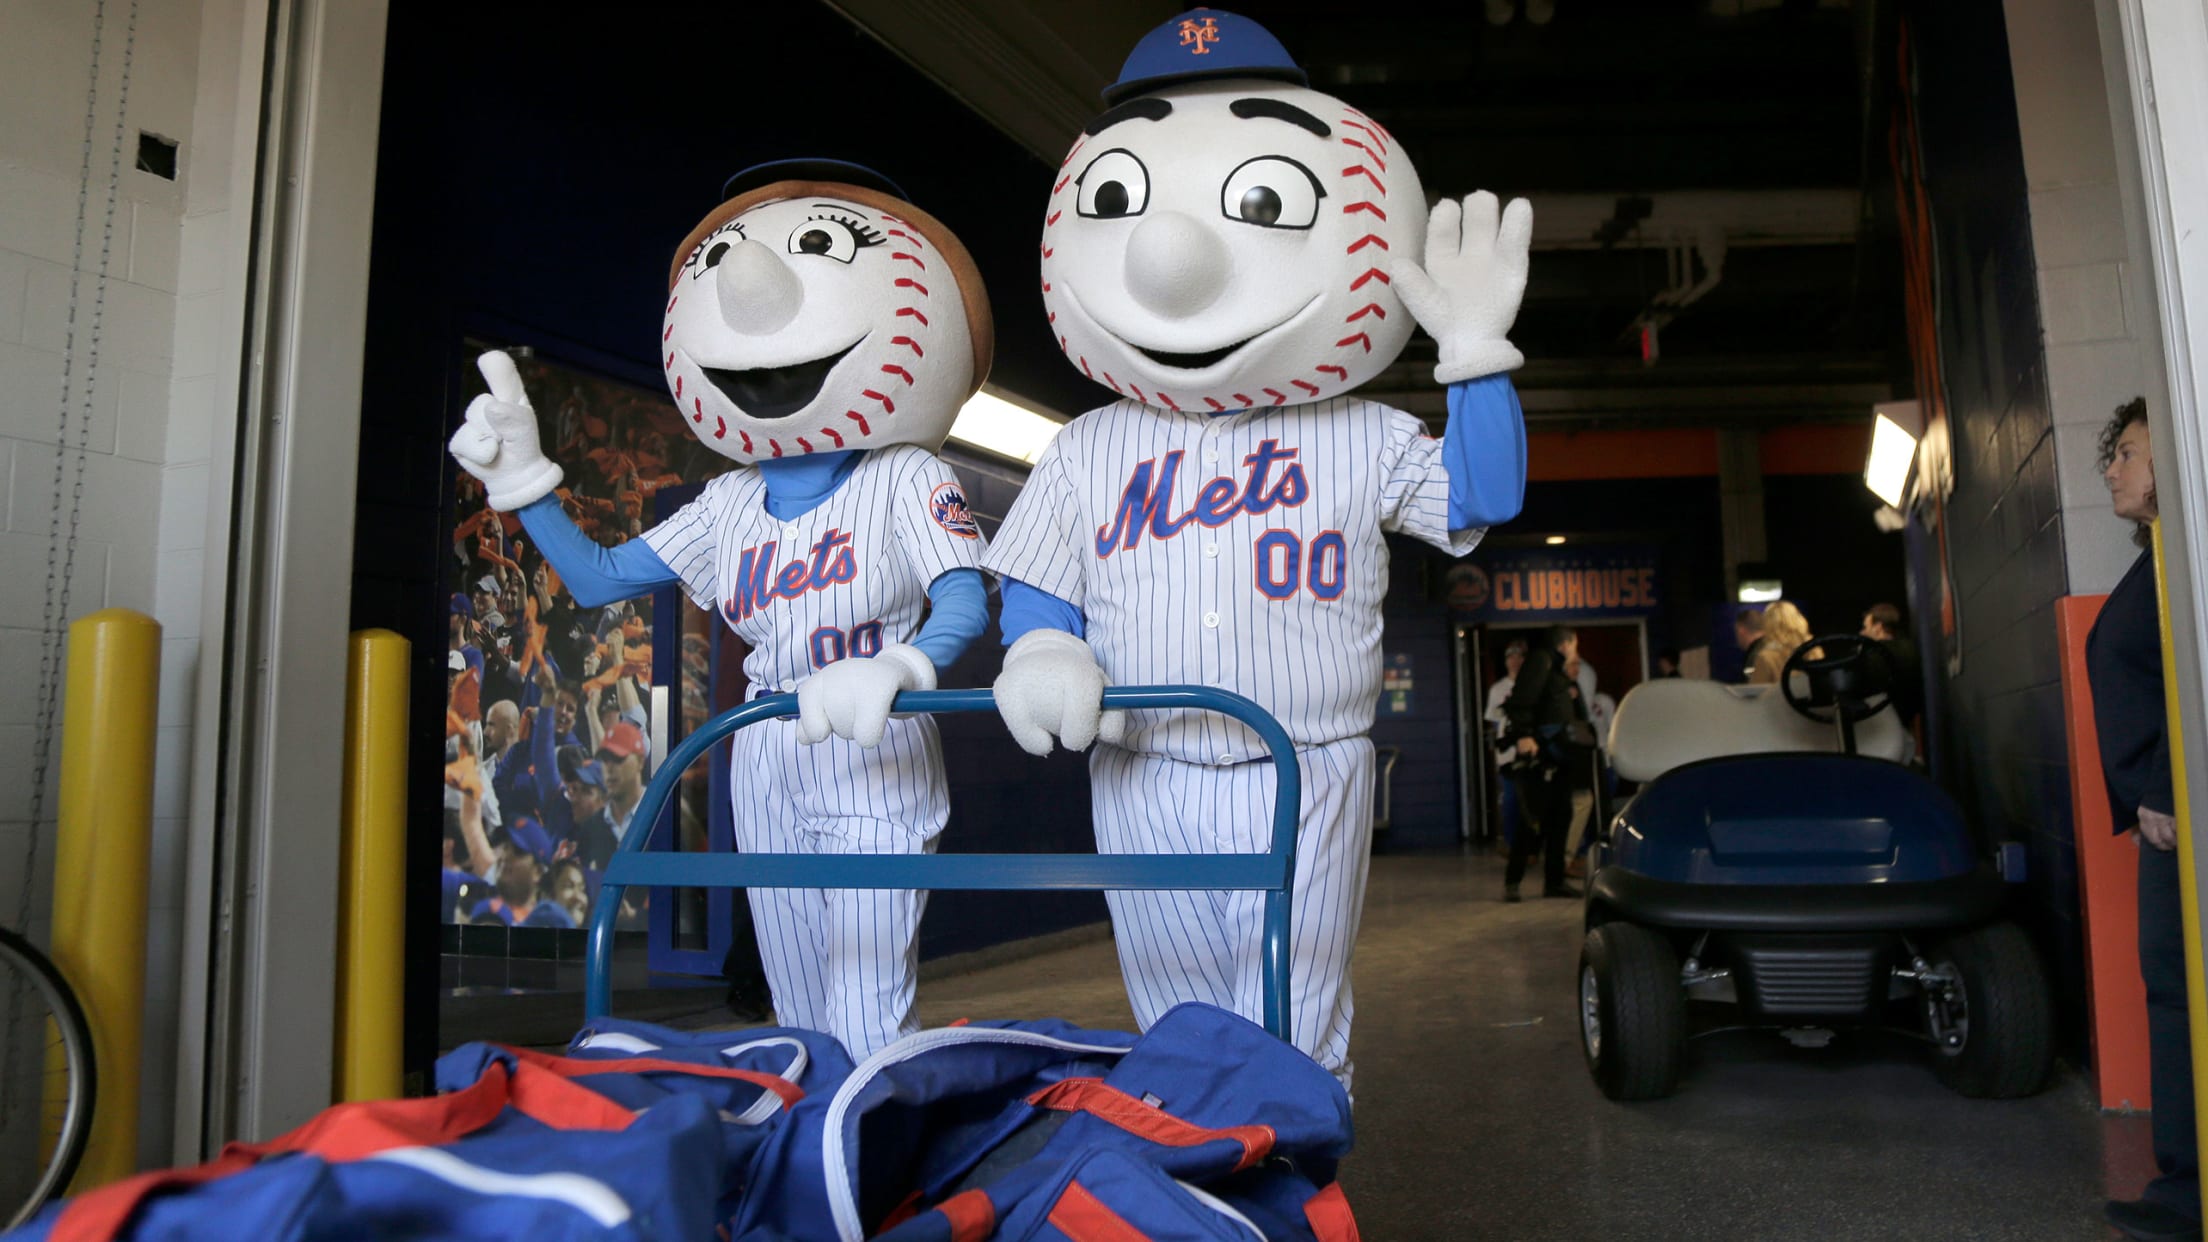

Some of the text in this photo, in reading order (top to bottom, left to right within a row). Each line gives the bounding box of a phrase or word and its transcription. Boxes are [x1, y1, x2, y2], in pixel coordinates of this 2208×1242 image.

[1095, 438, 1310, 561] Mets
[724, 527, 858, 625] Mets
[1254, 528, 1347, 602] 00
[1494, 568, 1657, 610] CLUBHOUSE
